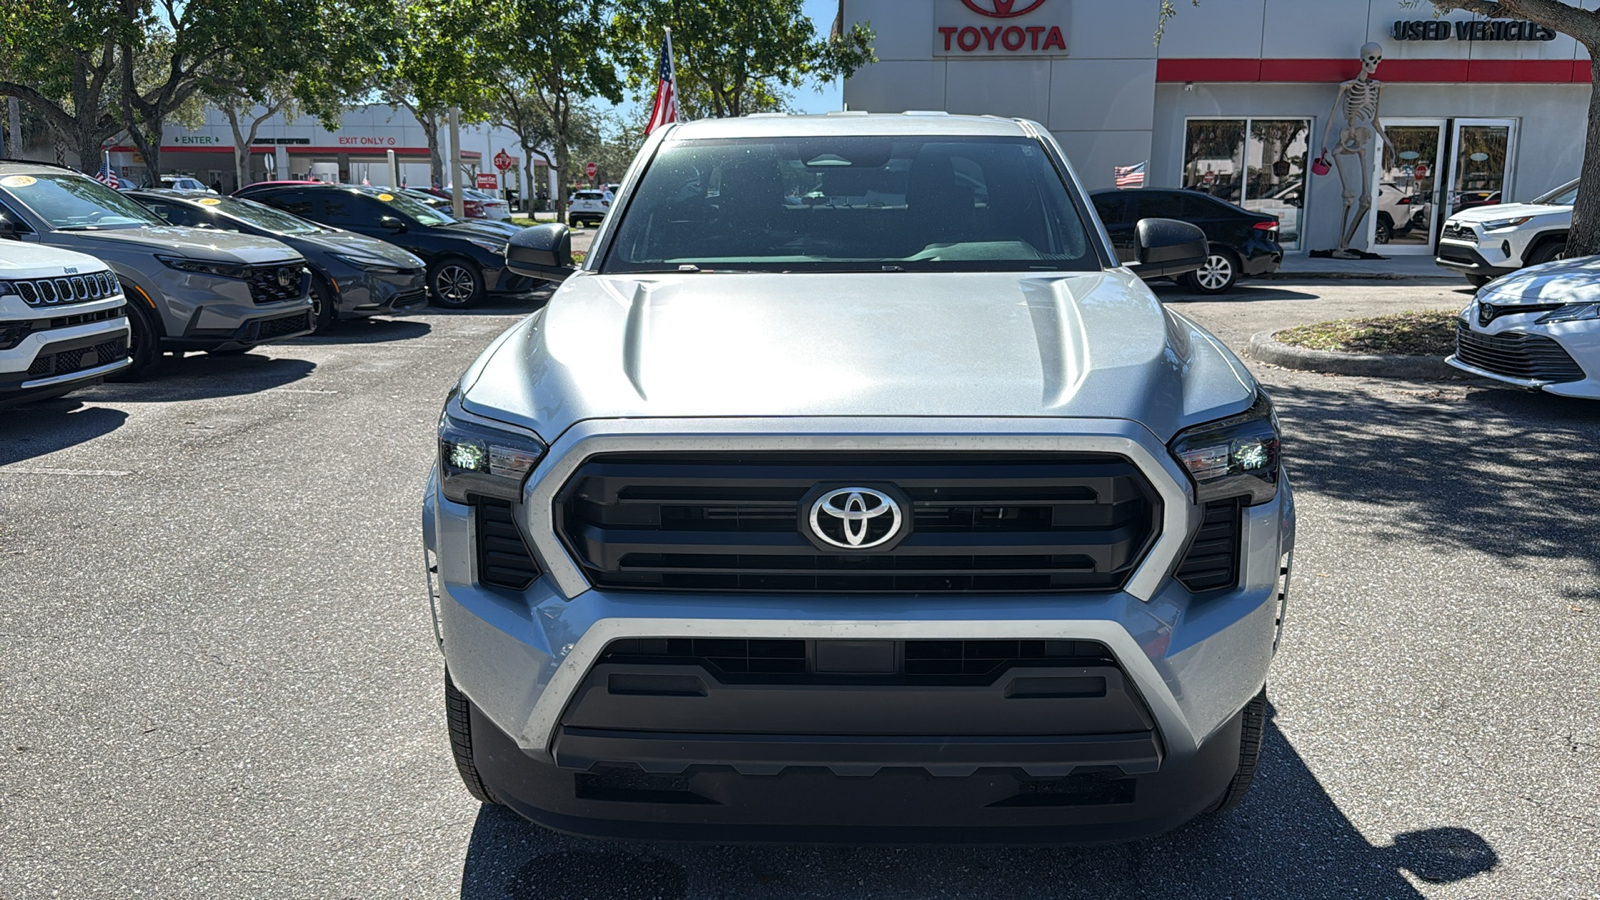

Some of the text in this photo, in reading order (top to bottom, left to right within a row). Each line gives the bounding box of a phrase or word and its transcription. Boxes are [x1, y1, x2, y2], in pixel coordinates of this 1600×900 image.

[1393, 20, 1557, 41] USED VEHICLES
[938, 26, 1067, 51] TOYOTA
[182, 136, 212, 144] ENTER
[339, 137, 384, 145] EXIT ONLY
